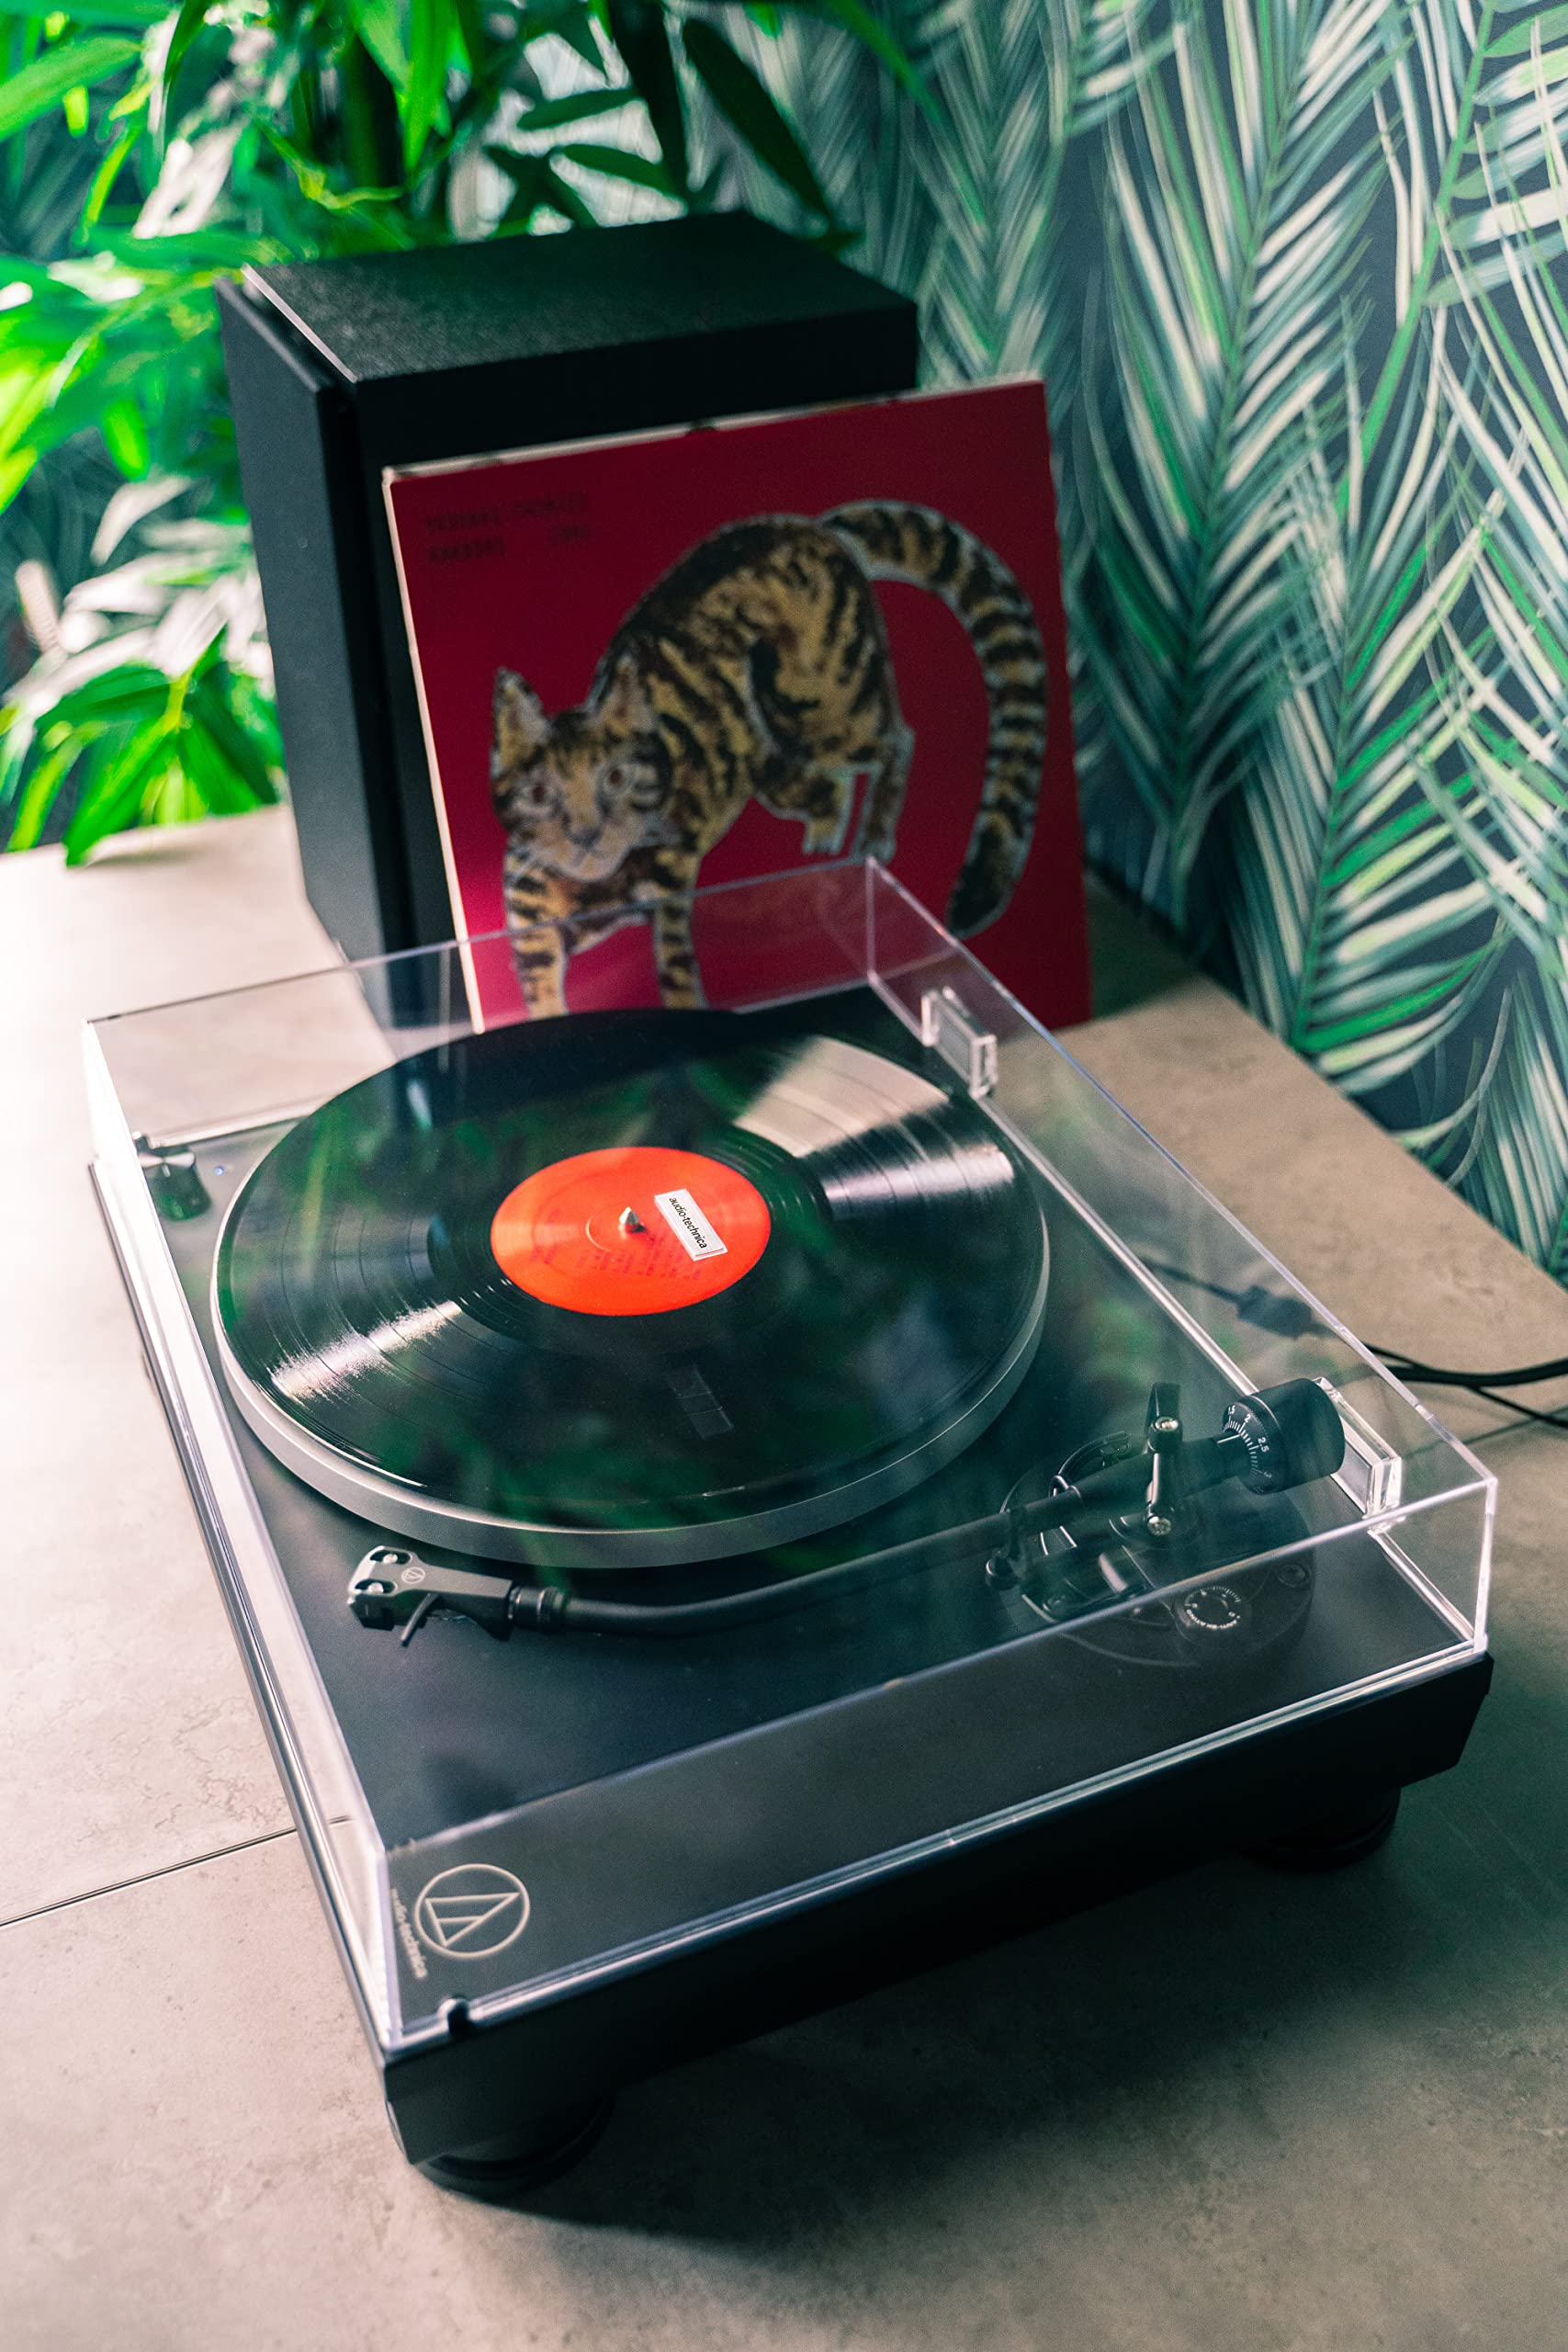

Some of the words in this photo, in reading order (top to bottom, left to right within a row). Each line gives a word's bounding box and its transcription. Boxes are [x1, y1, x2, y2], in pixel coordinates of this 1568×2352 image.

[669, 1197, 707, 1249] audio-technica
[1245, 1414, 1251, 1423] 2
[1258, 1437, 1269, 1453] 2.5
